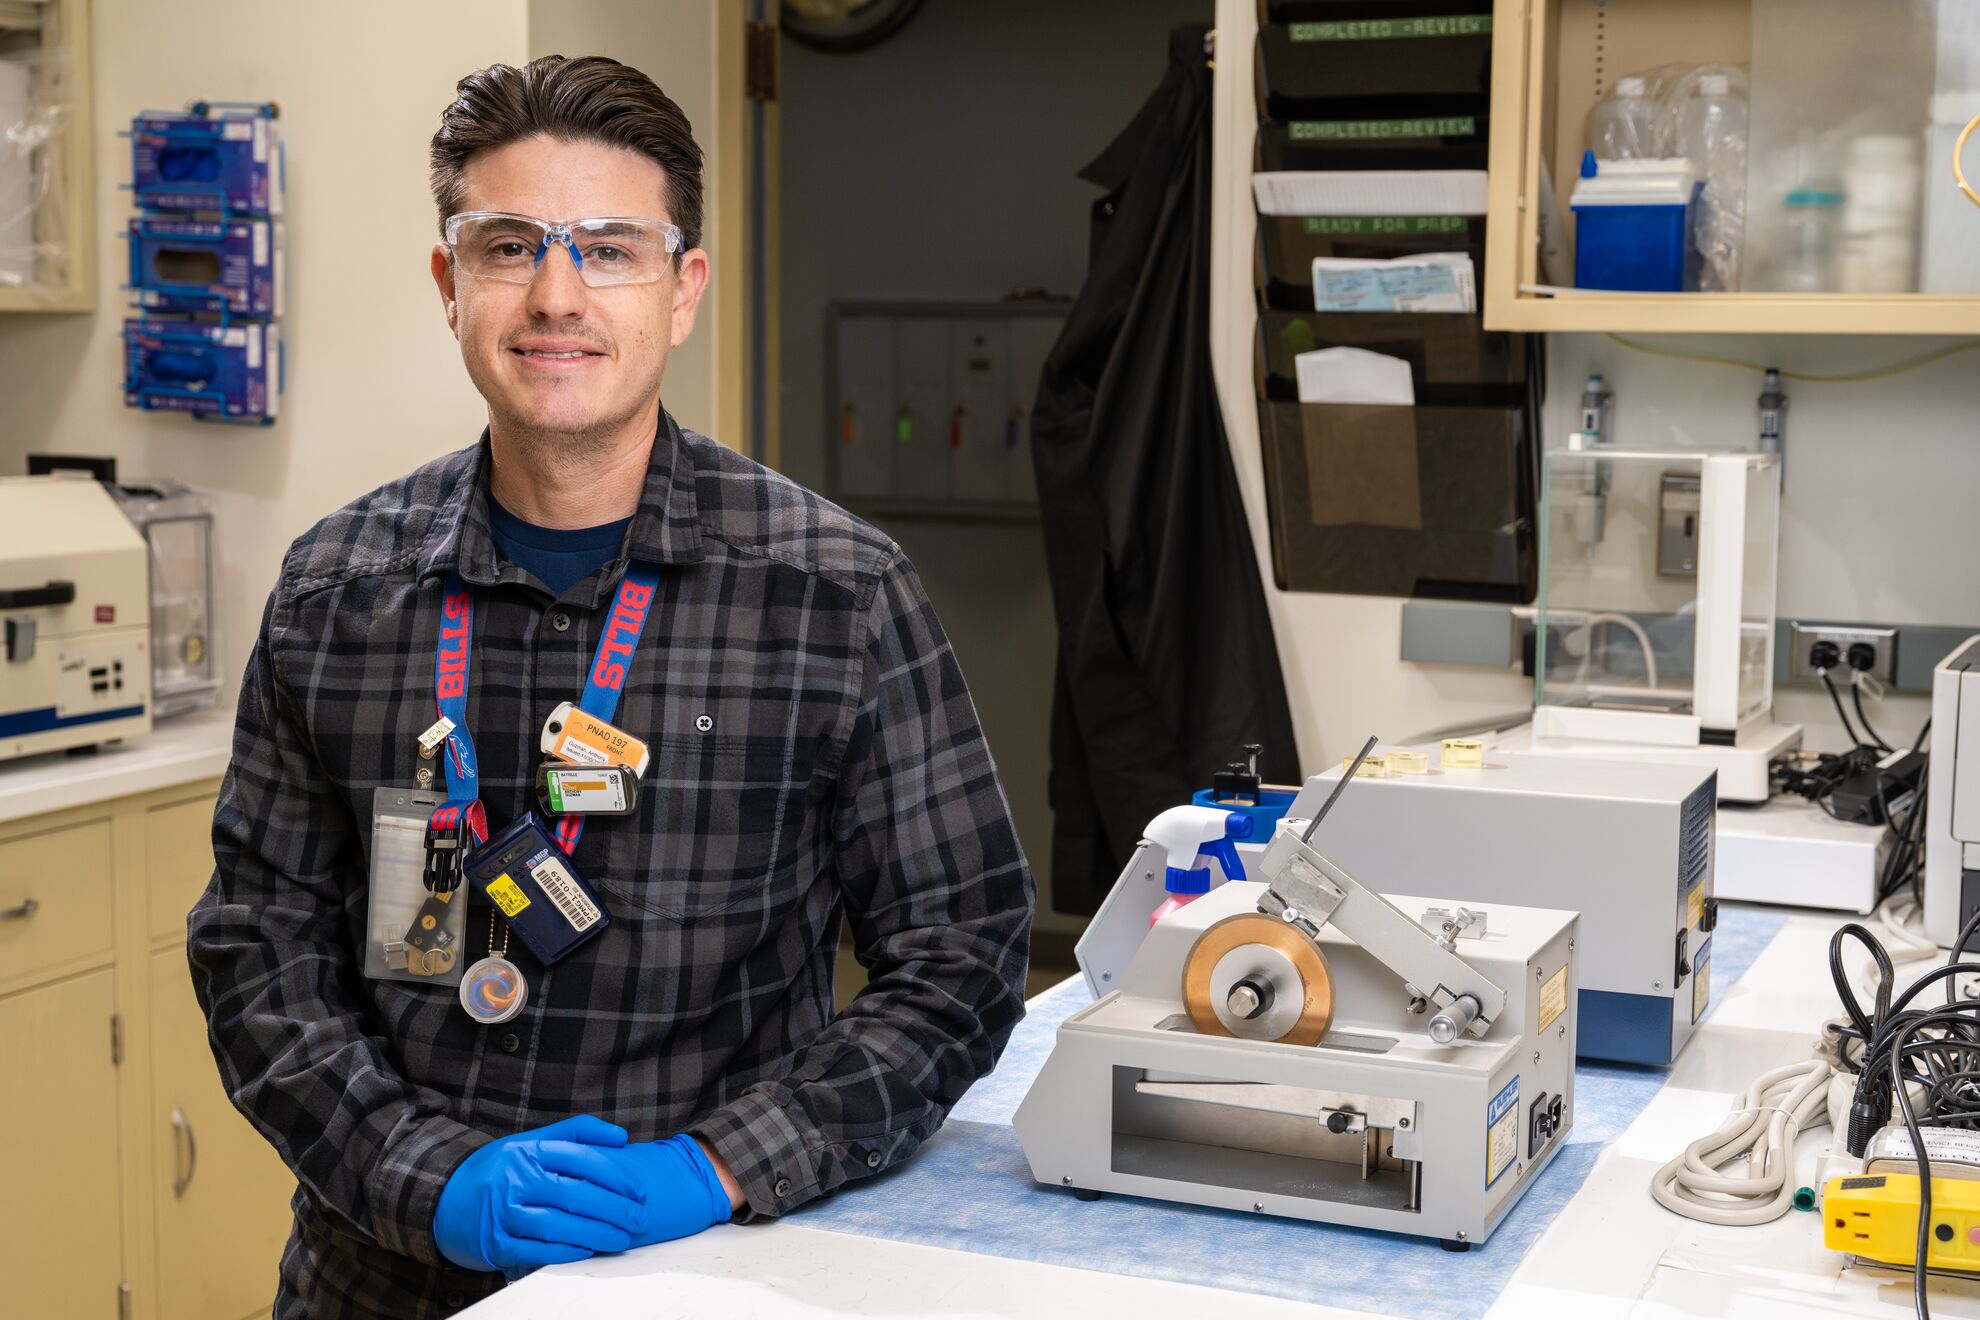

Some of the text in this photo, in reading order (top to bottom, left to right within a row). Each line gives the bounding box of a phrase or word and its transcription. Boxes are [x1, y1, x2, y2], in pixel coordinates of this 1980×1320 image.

[1292, 20, 1392, 40] COMPLETED
[1308, 216, 1460, 232] READY FOR PREP
[437, 591, 470, 699] BILLS
[593, 579, 653, 691] BILLS
[586, 723, 628, 749] PNAD 197
[606, 744, 624, 756] FRONT
[533, 848, 549, 862] MGP
[550, 869, 594, 923] PPMG1-0189
